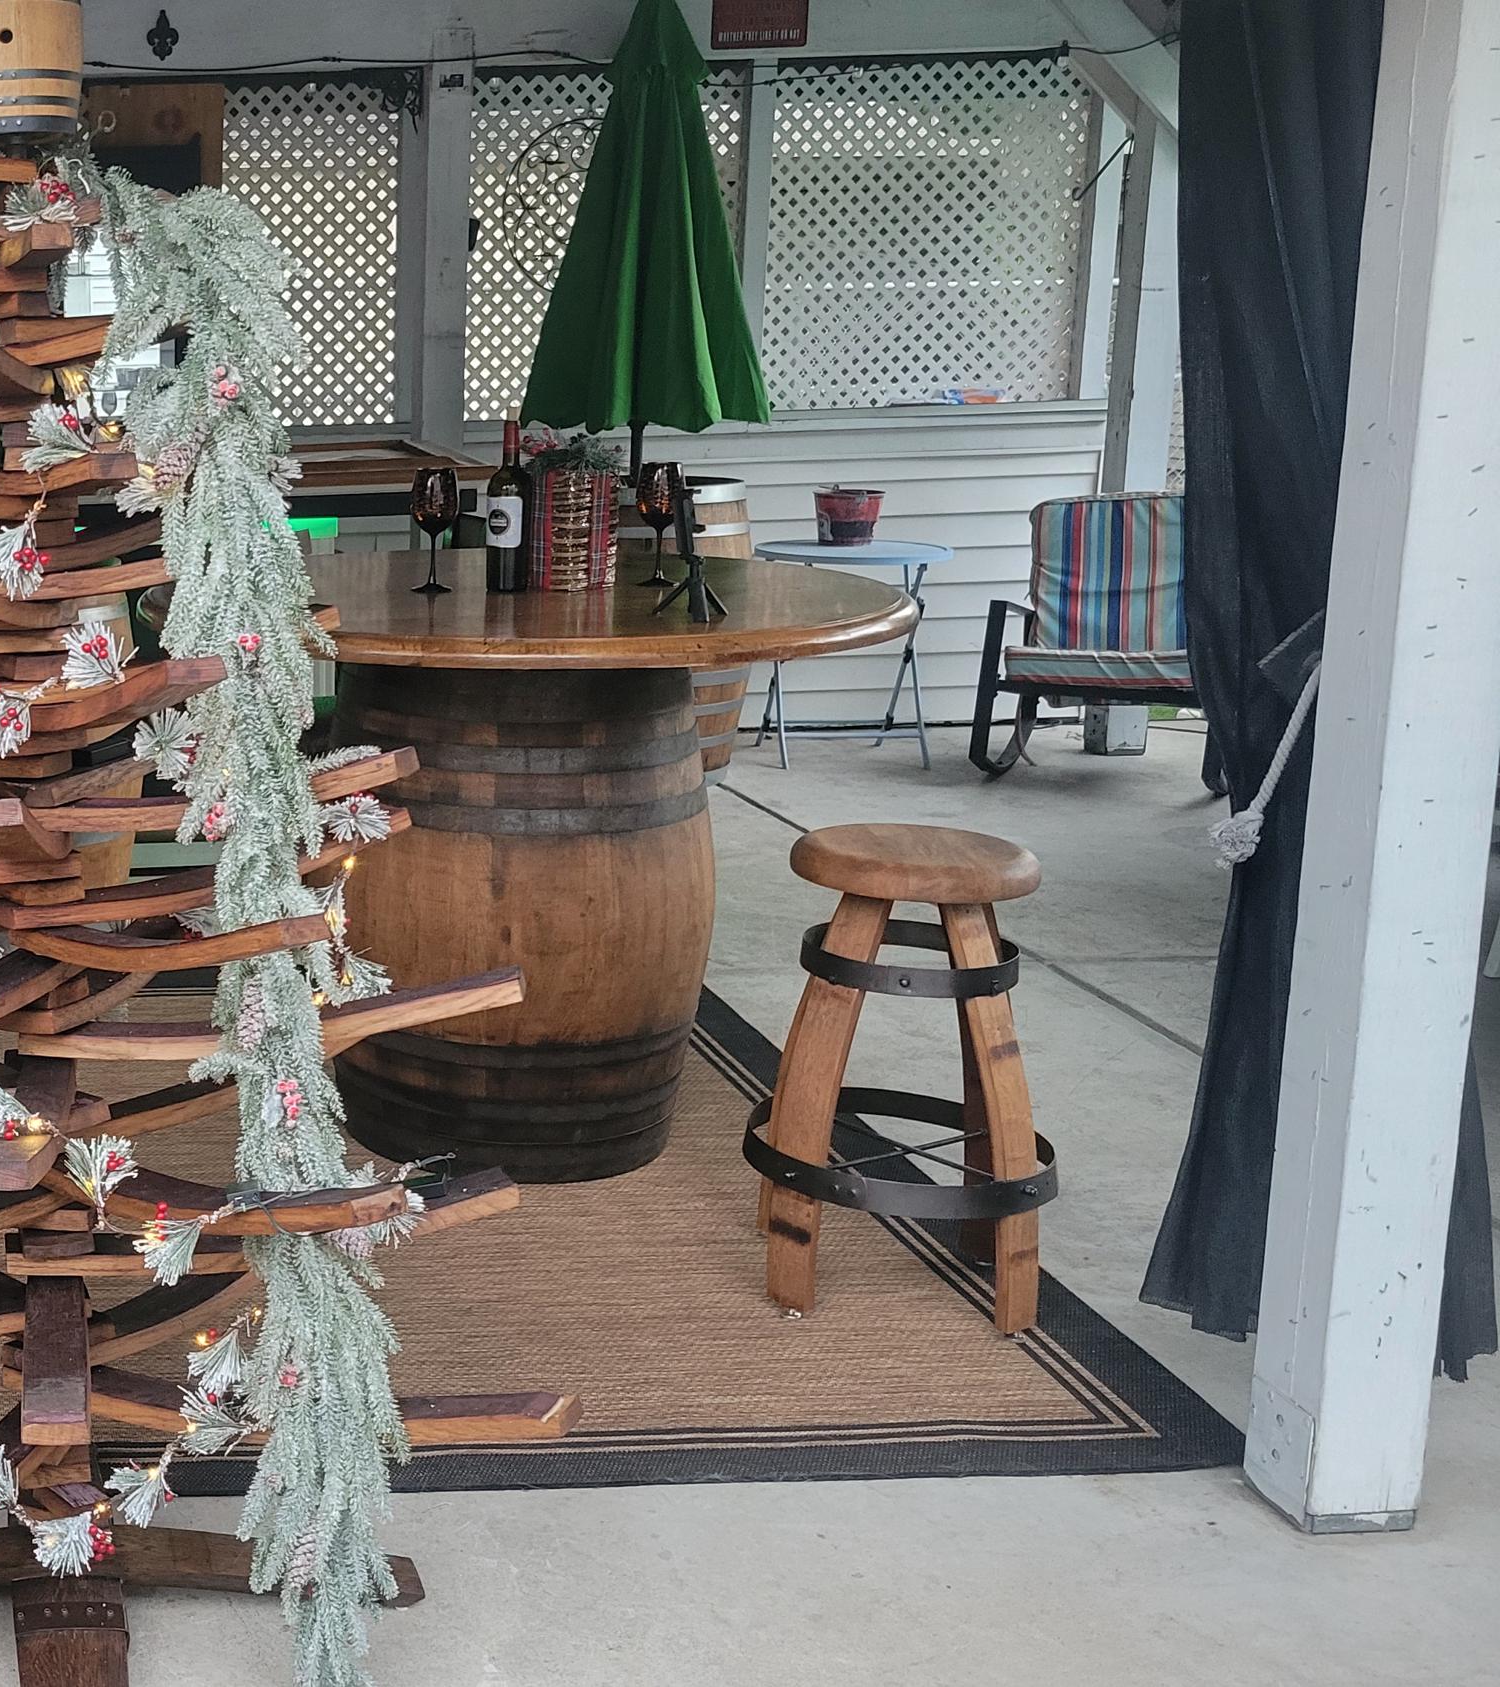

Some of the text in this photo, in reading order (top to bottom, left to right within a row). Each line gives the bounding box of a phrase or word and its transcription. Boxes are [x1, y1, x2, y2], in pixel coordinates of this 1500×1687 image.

[718, 28, 800, 42] WHETHER THEY LIKE IT OR NOT
